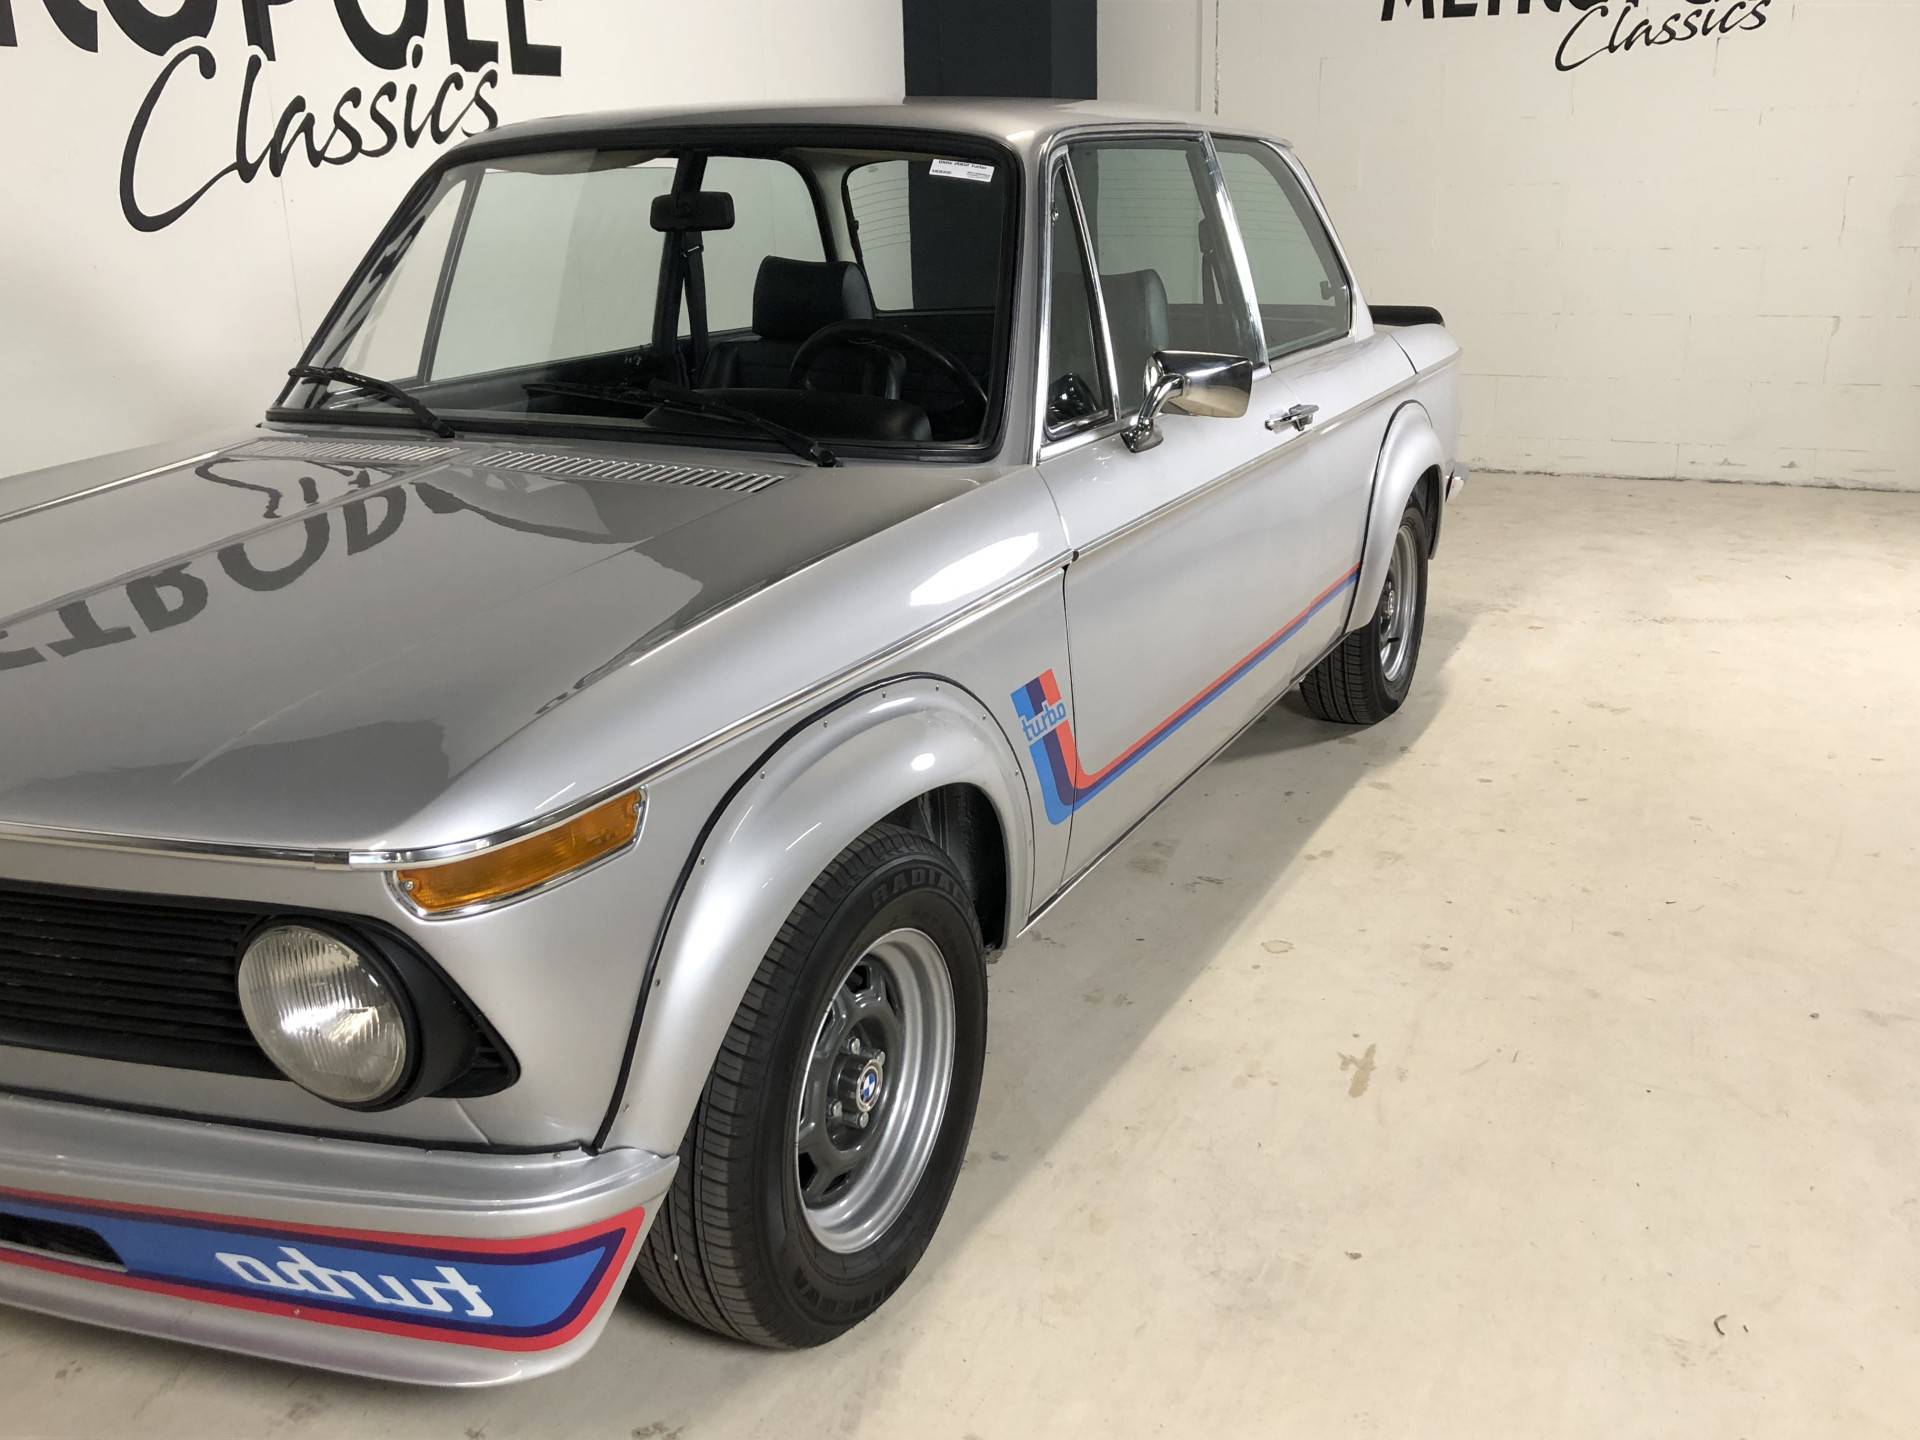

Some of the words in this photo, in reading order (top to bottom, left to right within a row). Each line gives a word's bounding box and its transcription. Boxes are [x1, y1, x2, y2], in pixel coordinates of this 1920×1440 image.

[1554, 0, 1771, 72] Classics
[119, 45, 499, 233] Classics
[1021, 702, 1067, 741] turbo
